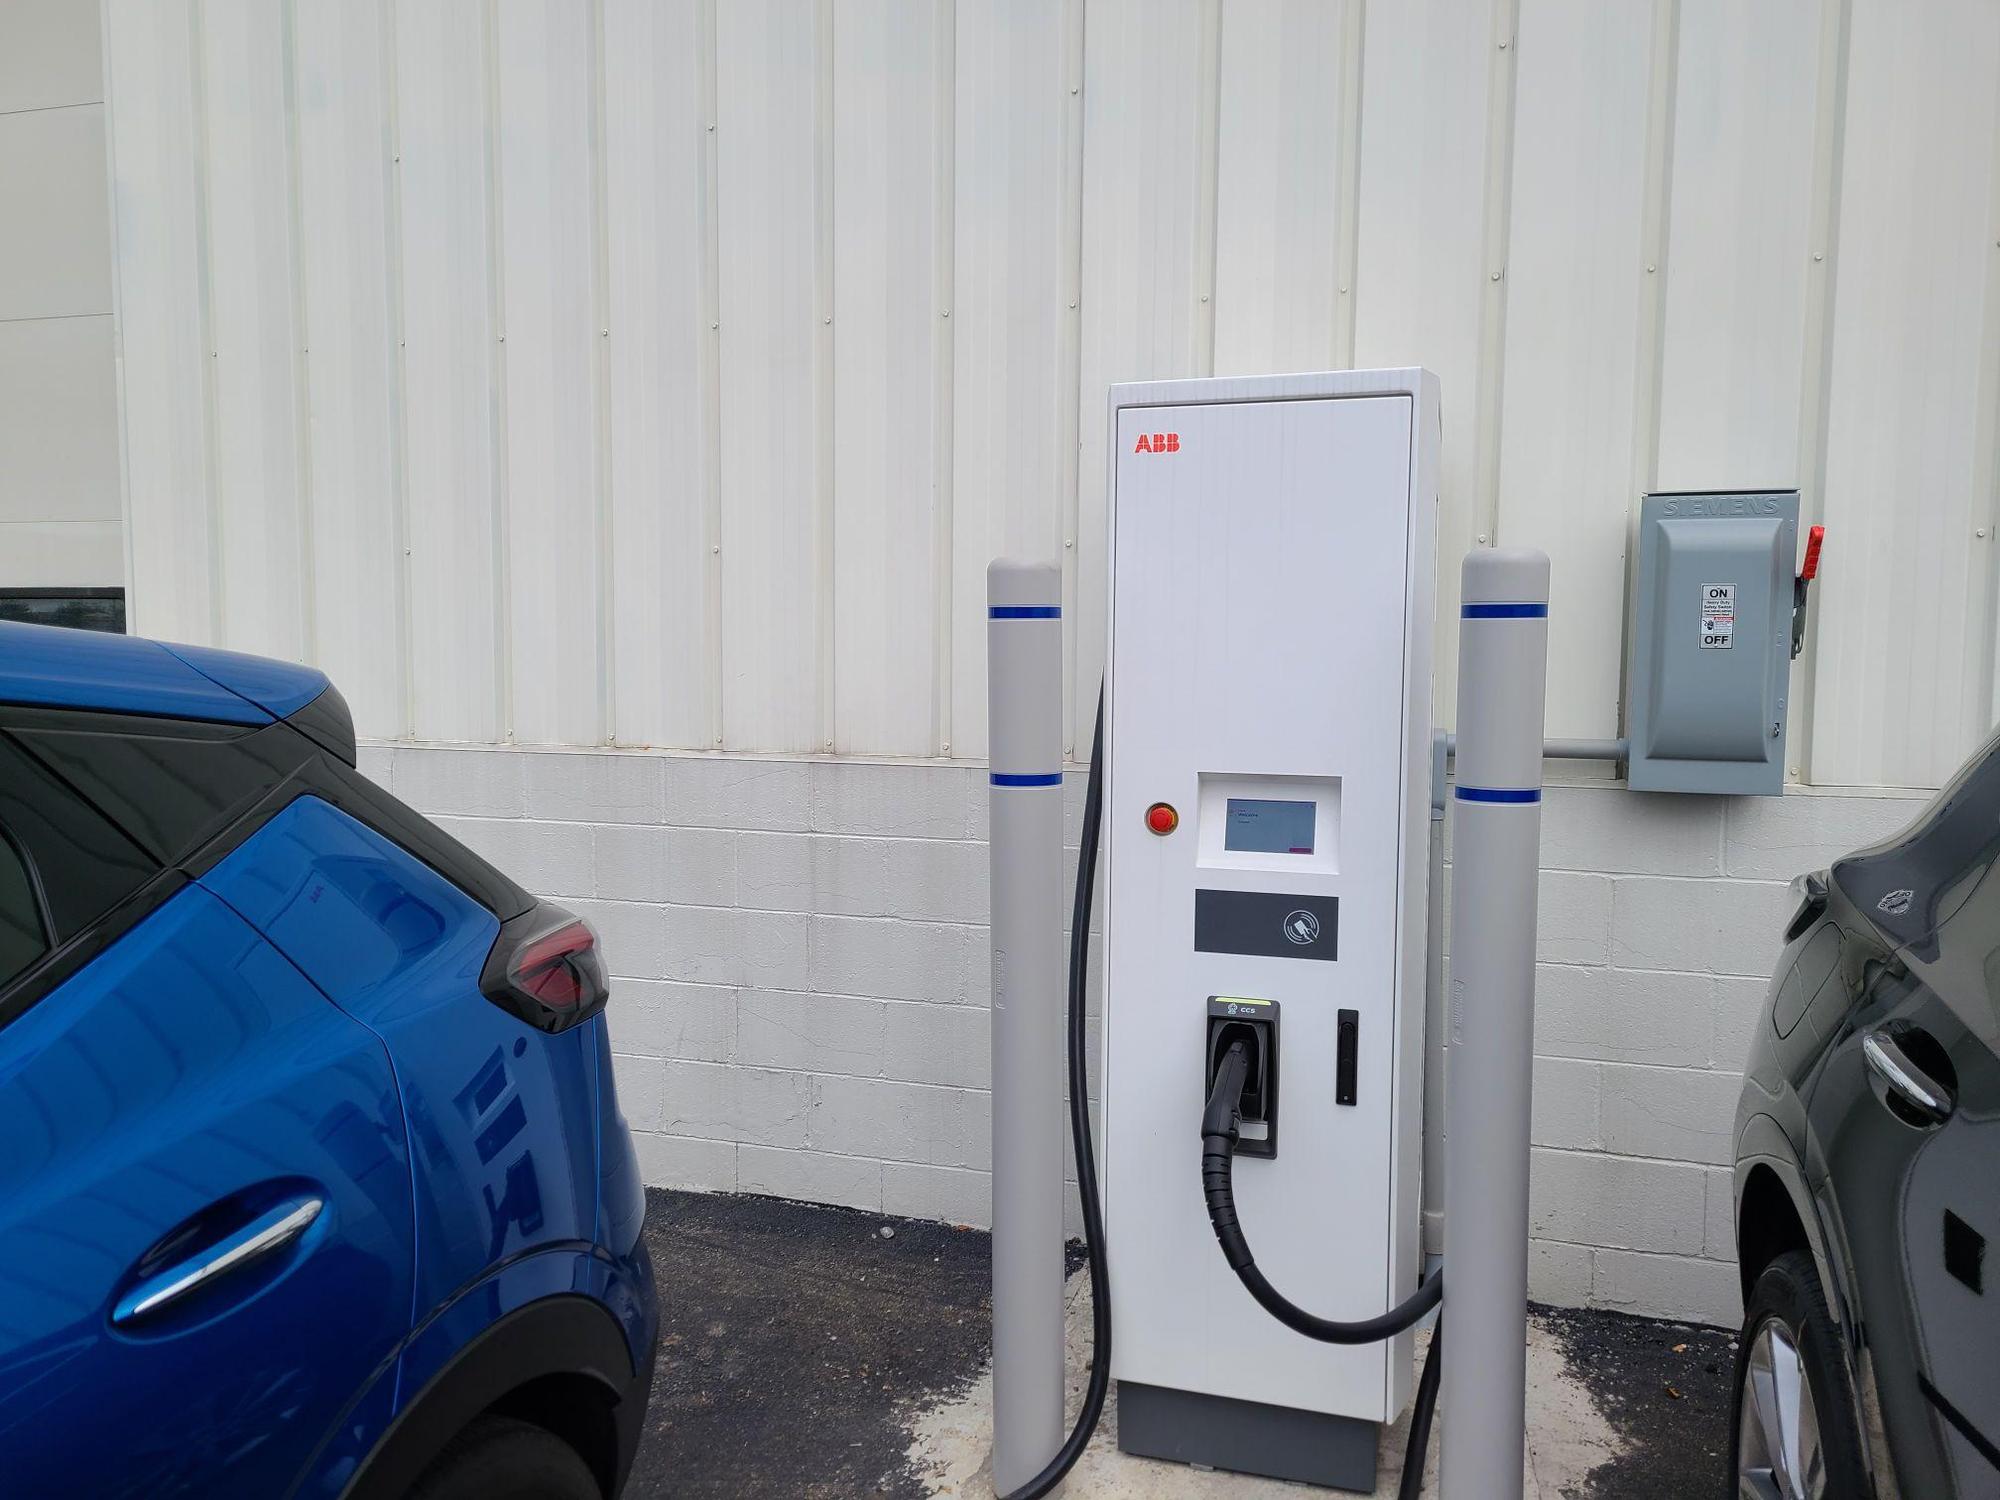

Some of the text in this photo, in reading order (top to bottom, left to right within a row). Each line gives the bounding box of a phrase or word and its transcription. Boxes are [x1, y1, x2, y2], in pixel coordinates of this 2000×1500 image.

[1135, 433, 1180, 453] ABB
[1663, 496, 1779, 516] SIEMENS
[1709, 589, 1728, 598] ON
[1704, 636, 1728, 644] OFF
